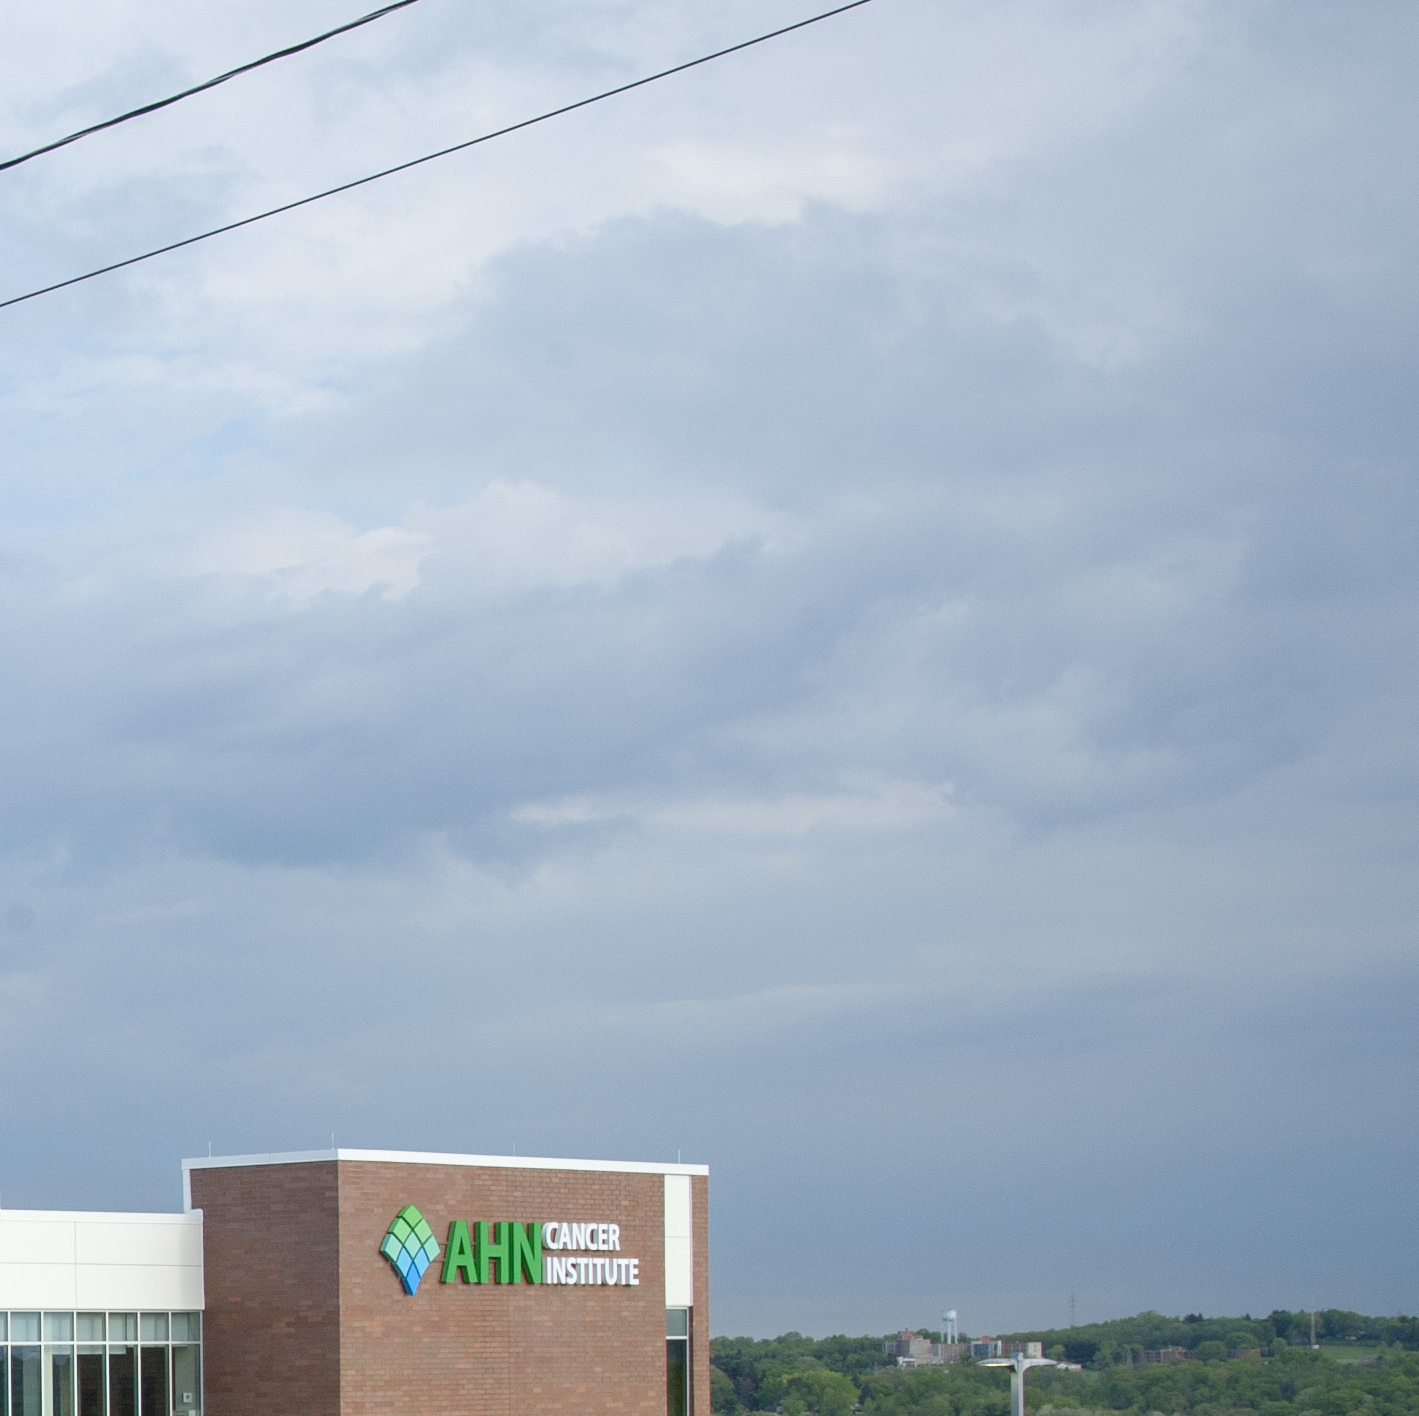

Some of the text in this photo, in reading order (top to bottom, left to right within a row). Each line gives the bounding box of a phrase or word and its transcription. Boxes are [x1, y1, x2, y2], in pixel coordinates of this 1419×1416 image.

[542, 1222, 621, 1251] CANCER
[440, 1220, 543, 1284] AHN
[542, 1256, 640, 1286] INSTITUTE
